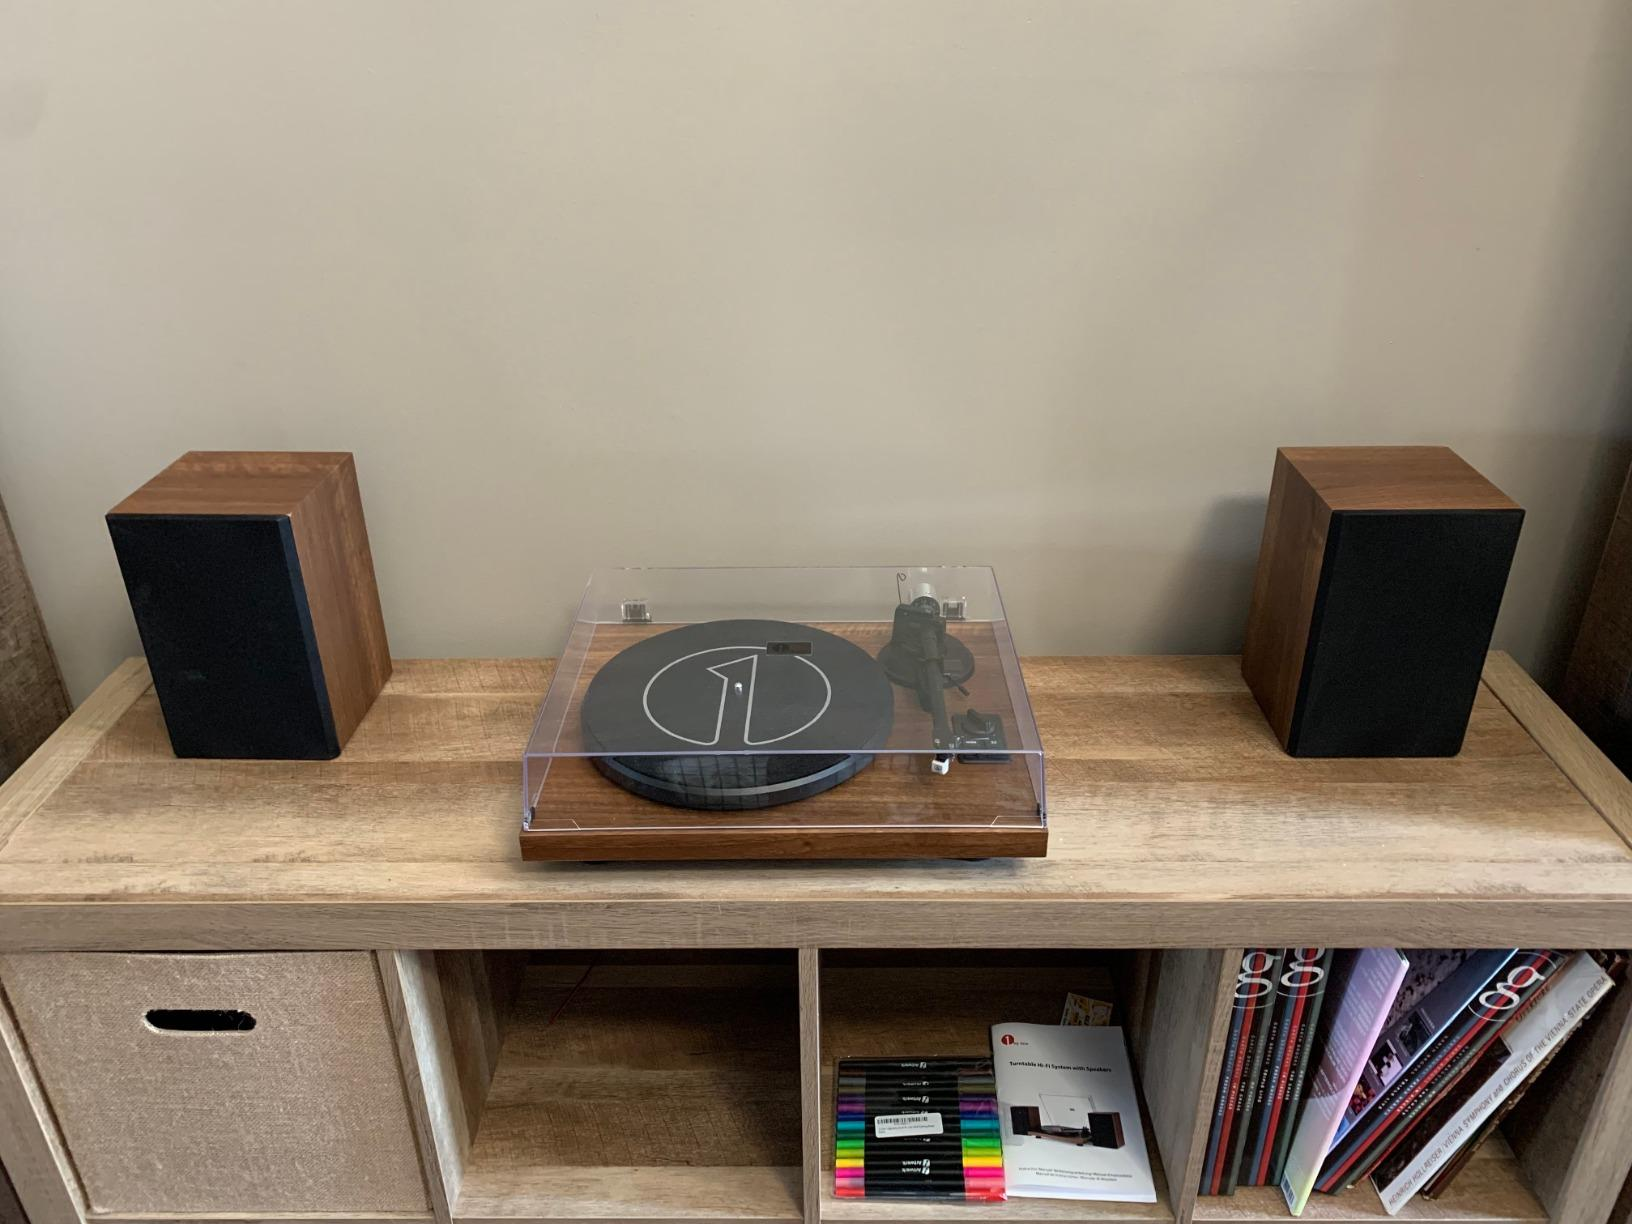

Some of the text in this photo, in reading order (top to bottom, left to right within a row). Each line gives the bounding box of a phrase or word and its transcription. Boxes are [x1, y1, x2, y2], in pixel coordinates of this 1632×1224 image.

[1037, 1061, 1051, 1069] Hi-Fi
[1462, 1095, 1494, 1127] SYMPHONY
[1500, 1059, 1527, 1086] CHORUS
[1523, 1050, 1536, 1063] OF
[1531, 1038, 1547, 1054] THE
[1543, 1015, 1569, 1042] VIENNA
[1566, 995, 1588, 1018] STATE
[1584, 974, 1608, 999] OPERA
